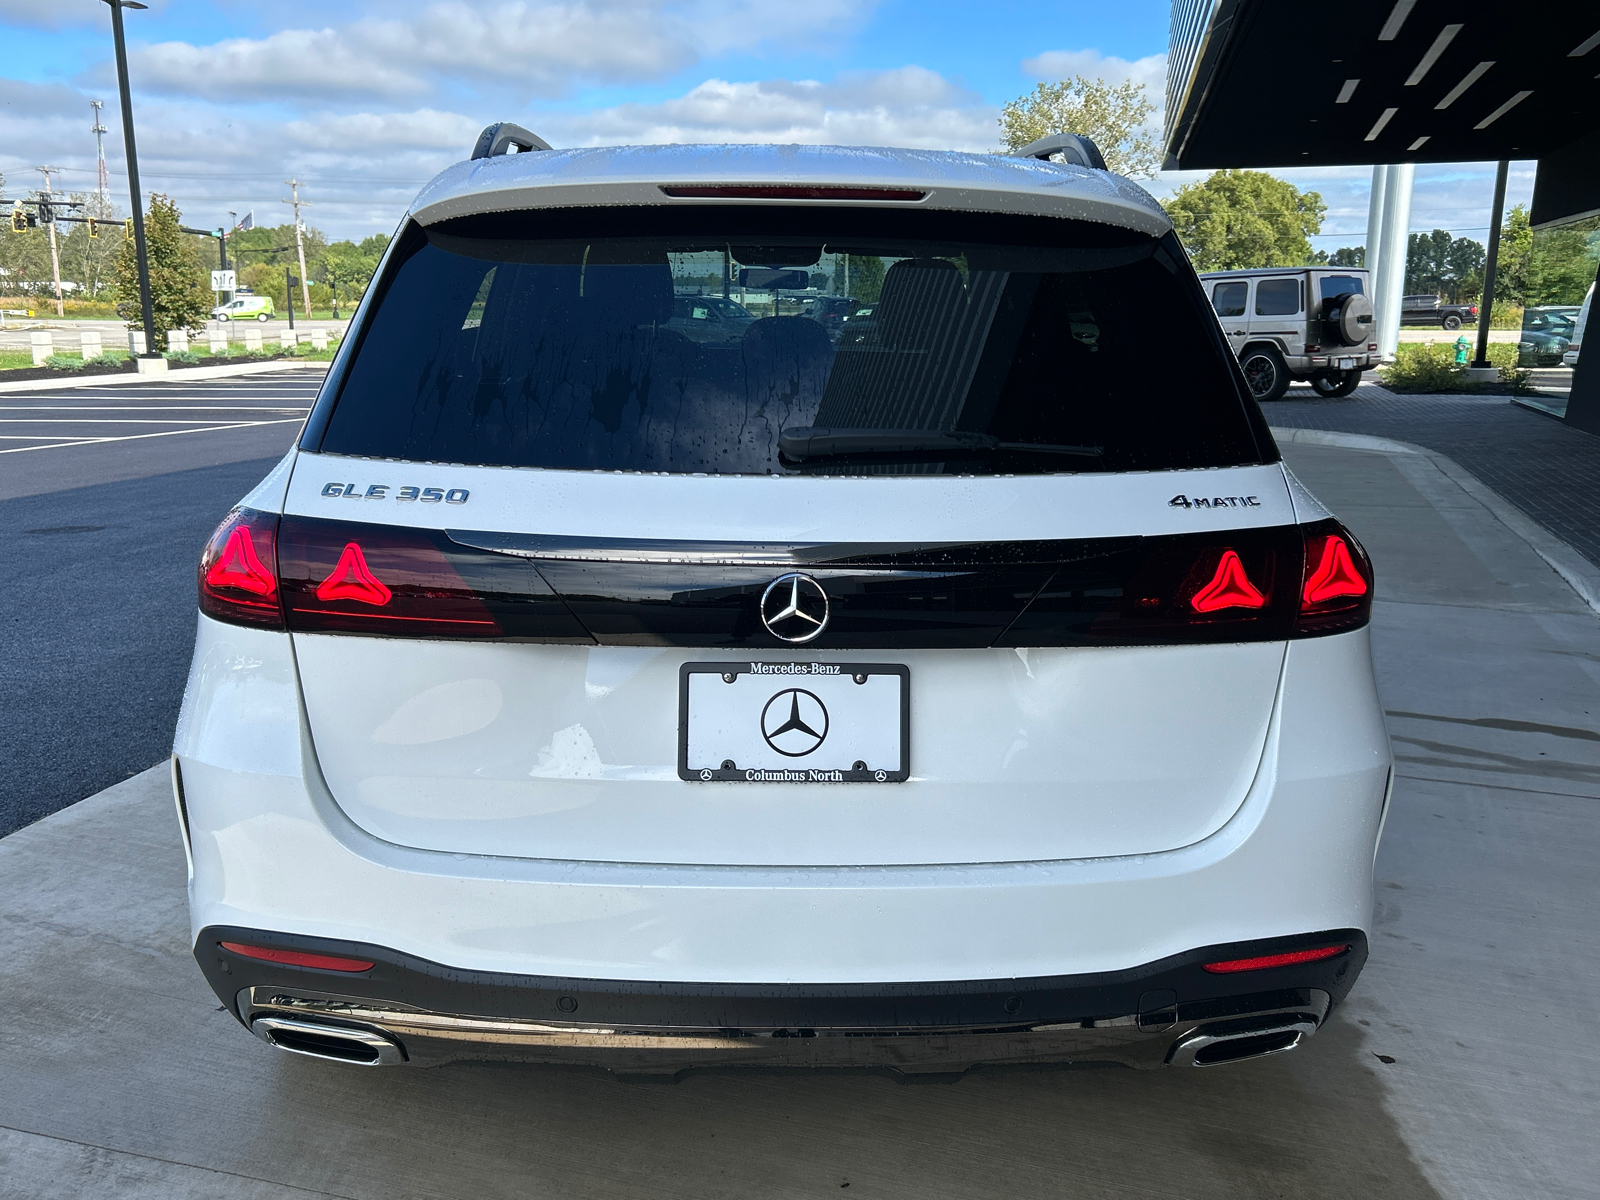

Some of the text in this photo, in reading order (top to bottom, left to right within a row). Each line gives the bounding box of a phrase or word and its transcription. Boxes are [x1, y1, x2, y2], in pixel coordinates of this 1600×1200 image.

[321, 482, 470, 505] GLE 350
[750, 662, 841, 675] Mercedes-Benz
[745, 769, 843, 782] Columbus North
